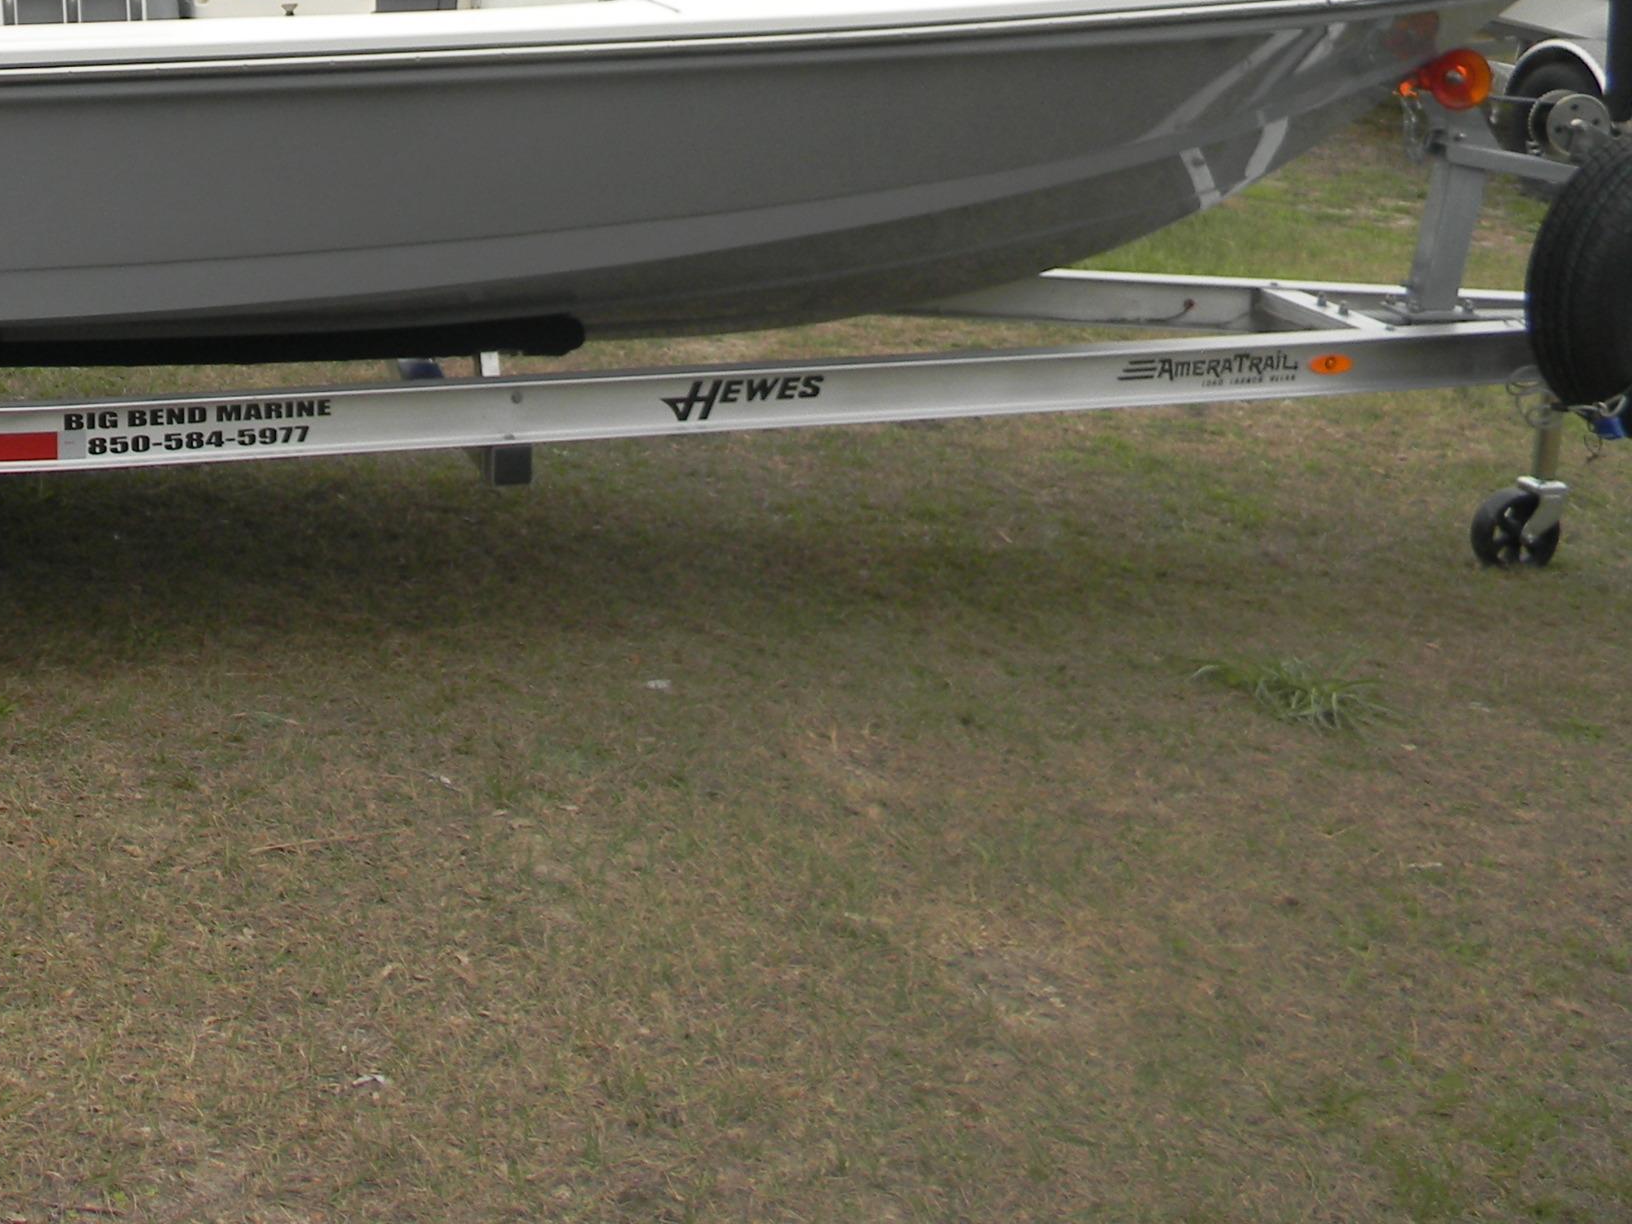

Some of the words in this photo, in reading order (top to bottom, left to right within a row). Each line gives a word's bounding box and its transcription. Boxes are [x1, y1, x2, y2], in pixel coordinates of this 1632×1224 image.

[63, 411, 119, 431] BIG
[127, 406, 207, 427] BEND
[216, 398, 332, 423] MARINE
[661, 375, 824, 421] HEWES
[87, 425, 310, 455] 850-584-5977
